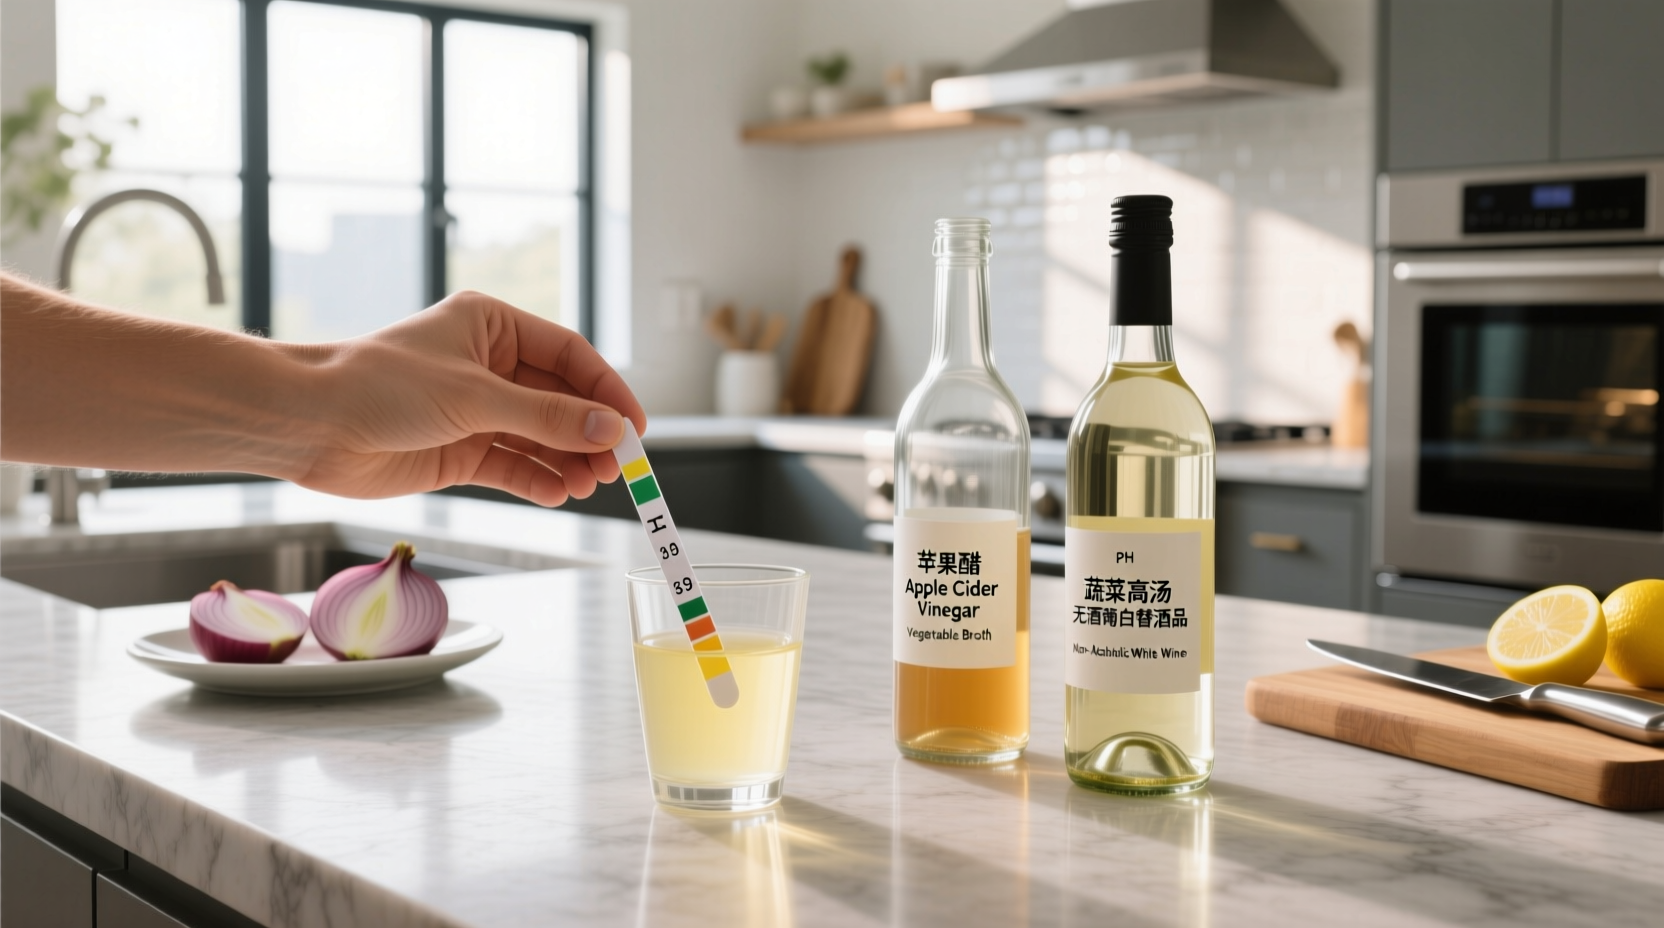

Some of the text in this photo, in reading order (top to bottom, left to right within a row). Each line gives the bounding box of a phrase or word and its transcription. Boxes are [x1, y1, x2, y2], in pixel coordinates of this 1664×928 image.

[917, 549, 982, 575] 苹果醋
[1116, 551, 1134, 564] PH
[673, 577, 693, 595] 39
[905, 578, 998, 599] Apple Cider
[1084, 575, 1172, 604] 蔬菜高汤
[918, 601, 980, 622] Vinegar
[962, 627, 992, 641] Broth
[1160, 647, 1187, 659] Wine
